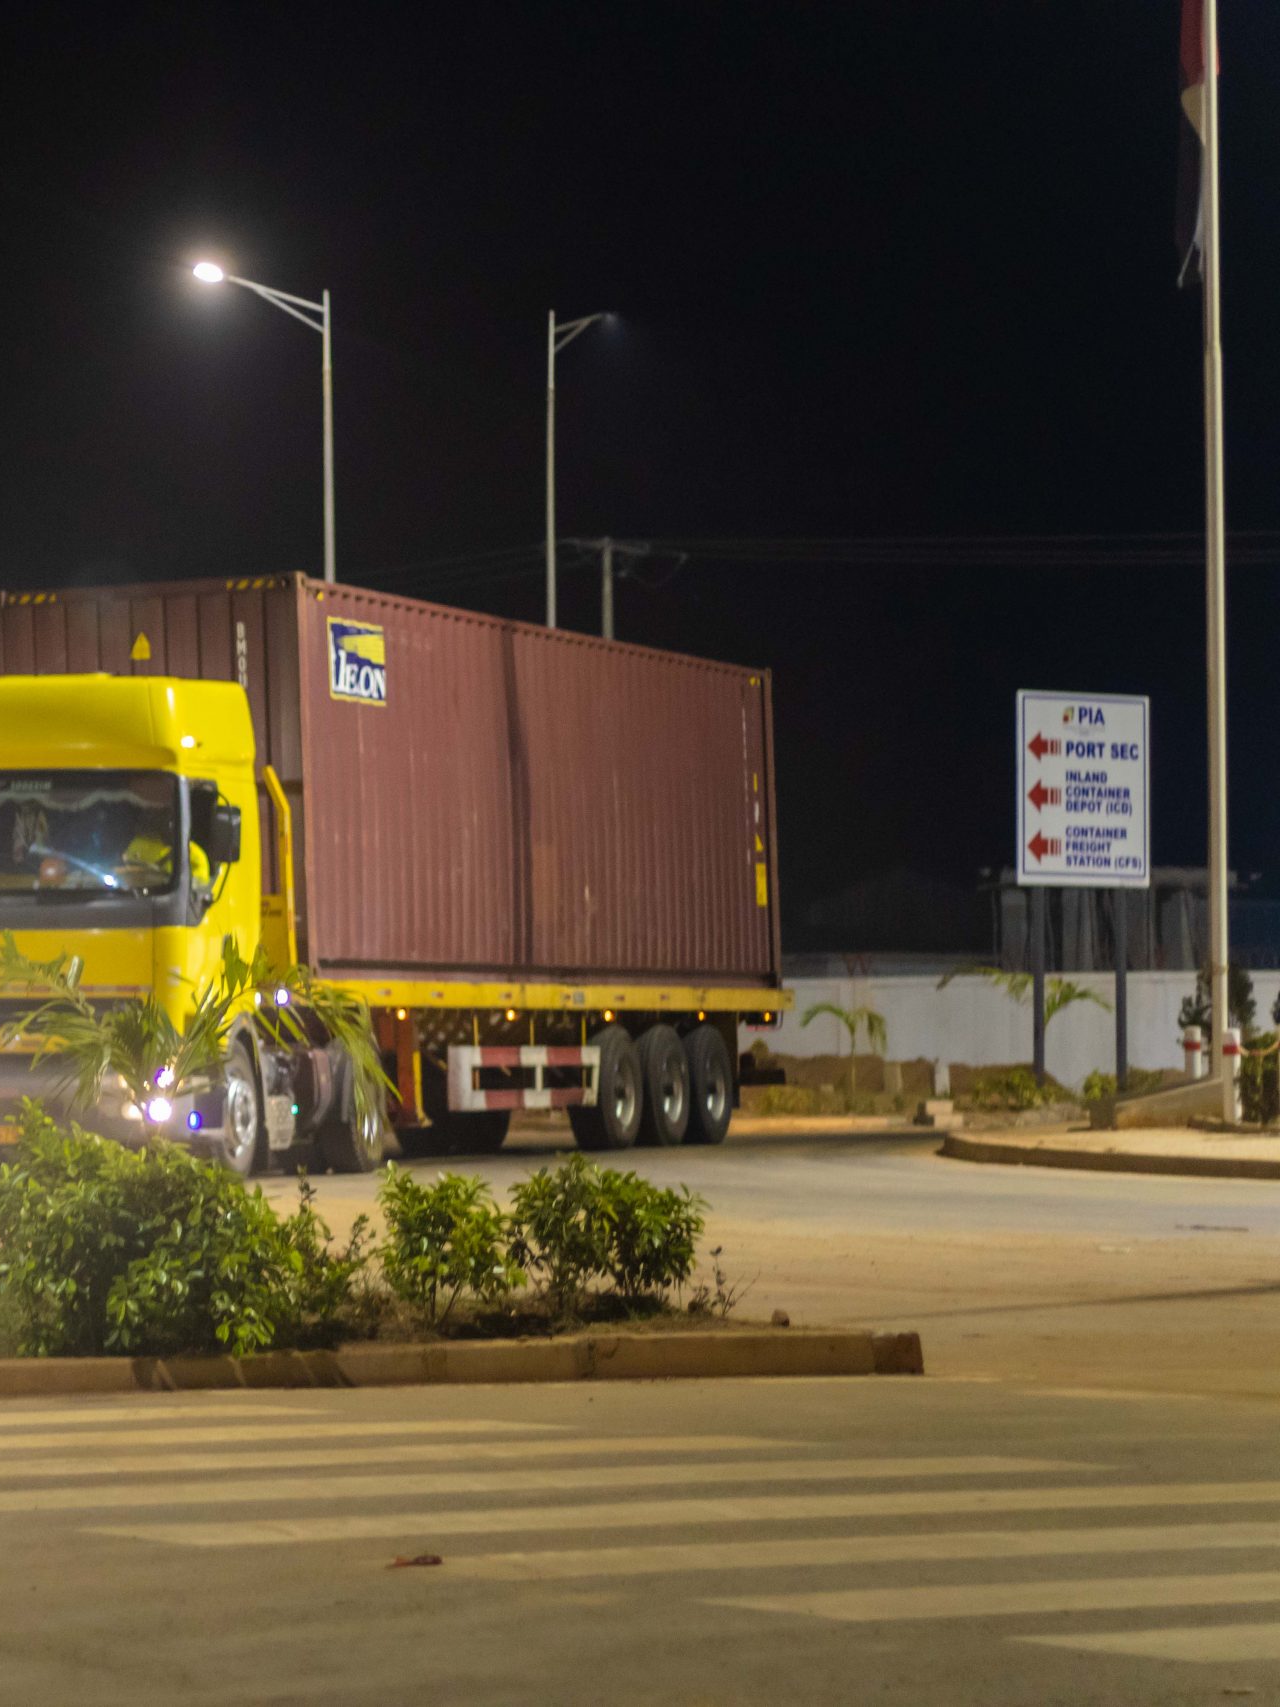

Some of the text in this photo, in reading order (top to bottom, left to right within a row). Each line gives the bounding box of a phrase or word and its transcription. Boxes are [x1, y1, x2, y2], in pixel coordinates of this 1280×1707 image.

[1078, 706, 1105, 726] PIA
[1065, 740, 1139, 761] PORT SEC
[1065, 771, 1108, 784] INLAND
[1065, 786, 1130, 799] CONTAINER
[1065, 801, 1133, 817] DEPOT (ICD)
[1065, 826, 1127, 840] CONTAINER
[1065, 841, 1111, 854] FREIGHT
[1066, 855, 1142, 870] STATION (CFS)
